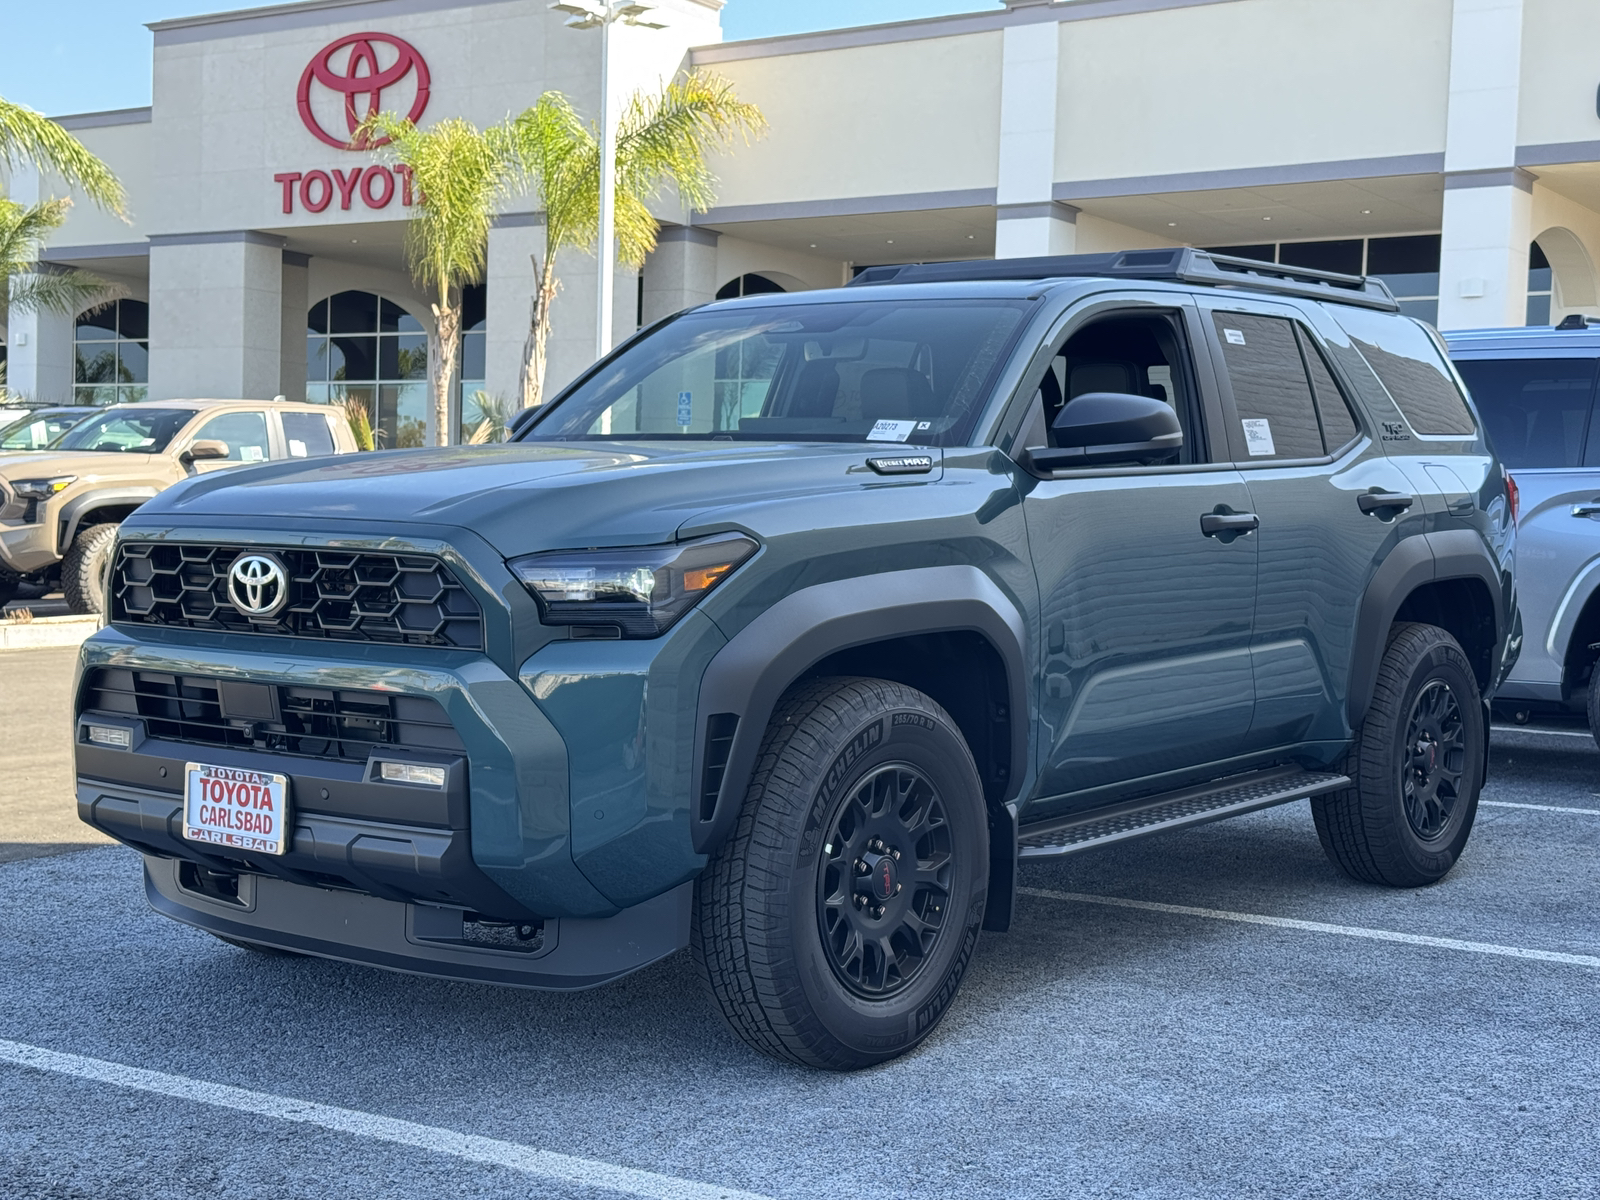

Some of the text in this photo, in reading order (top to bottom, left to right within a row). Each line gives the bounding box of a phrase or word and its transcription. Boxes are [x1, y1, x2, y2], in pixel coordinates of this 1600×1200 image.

[274, 164, 427, 214] TOYOT
[903, 457, 930, 467] MAX
[209, 767, 260, 784] TOYOTA
[813, 724, 880, 824] MICHELIN
[199, 777, 274, 812] TOYOTA
[199, 804, 273, 835] CARLSBAD
[187, 827, 278, 853] CARLSBAD
[918, 930, 976, 1031] MICHELIN
